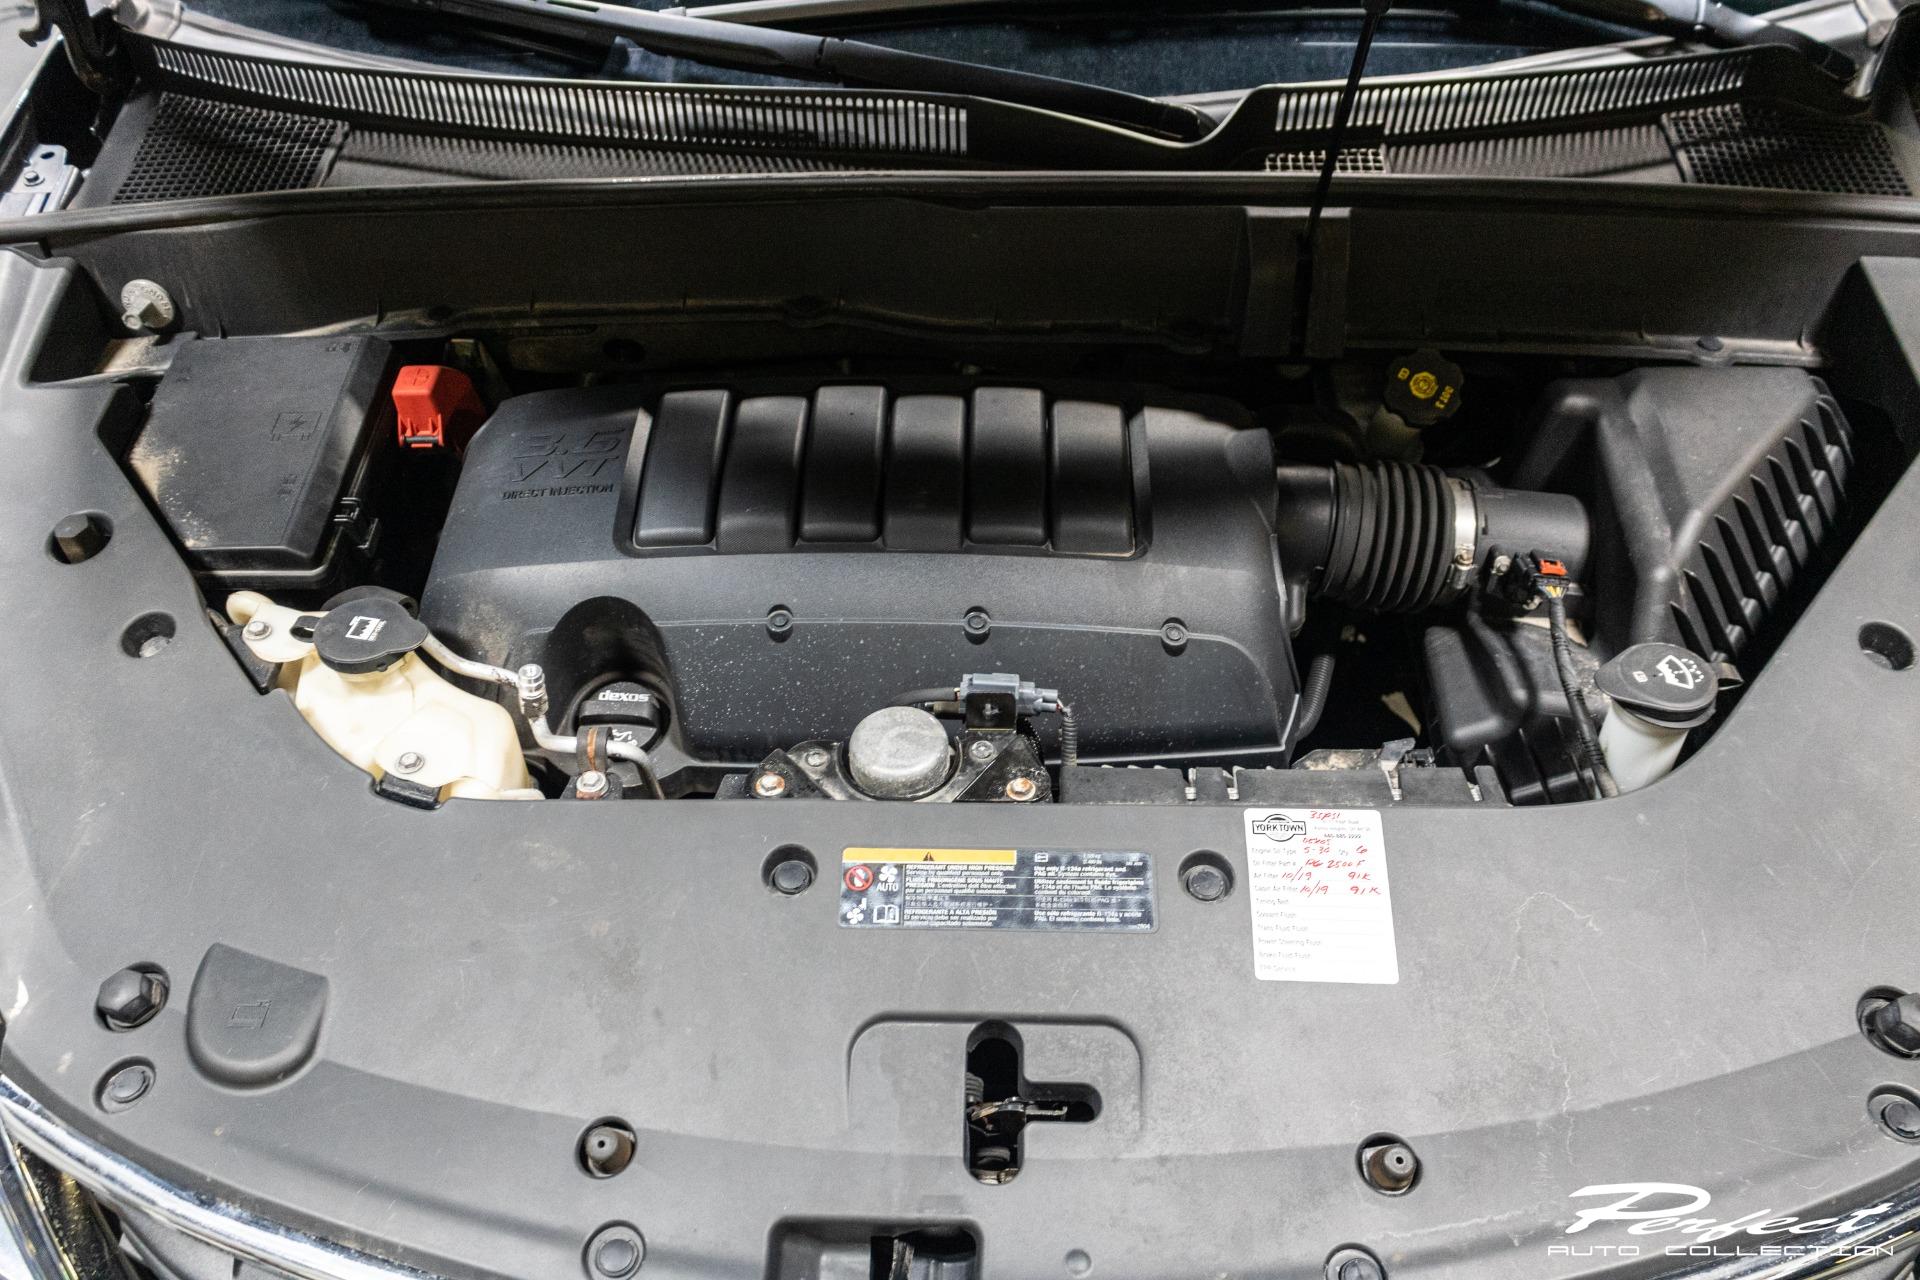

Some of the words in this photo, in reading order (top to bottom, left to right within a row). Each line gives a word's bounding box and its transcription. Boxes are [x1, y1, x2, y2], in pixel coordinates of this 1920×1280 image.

[512, 456, 620, 482] VVT
[502, 487, 546, 500] DIRECT
[550, 483, 614, 497] INJECTION
[598, 689, 652, 702] dexos
[1255, 824, 1304, 833] YORKTOWN
[876, 883, 899, 892] AUTO
